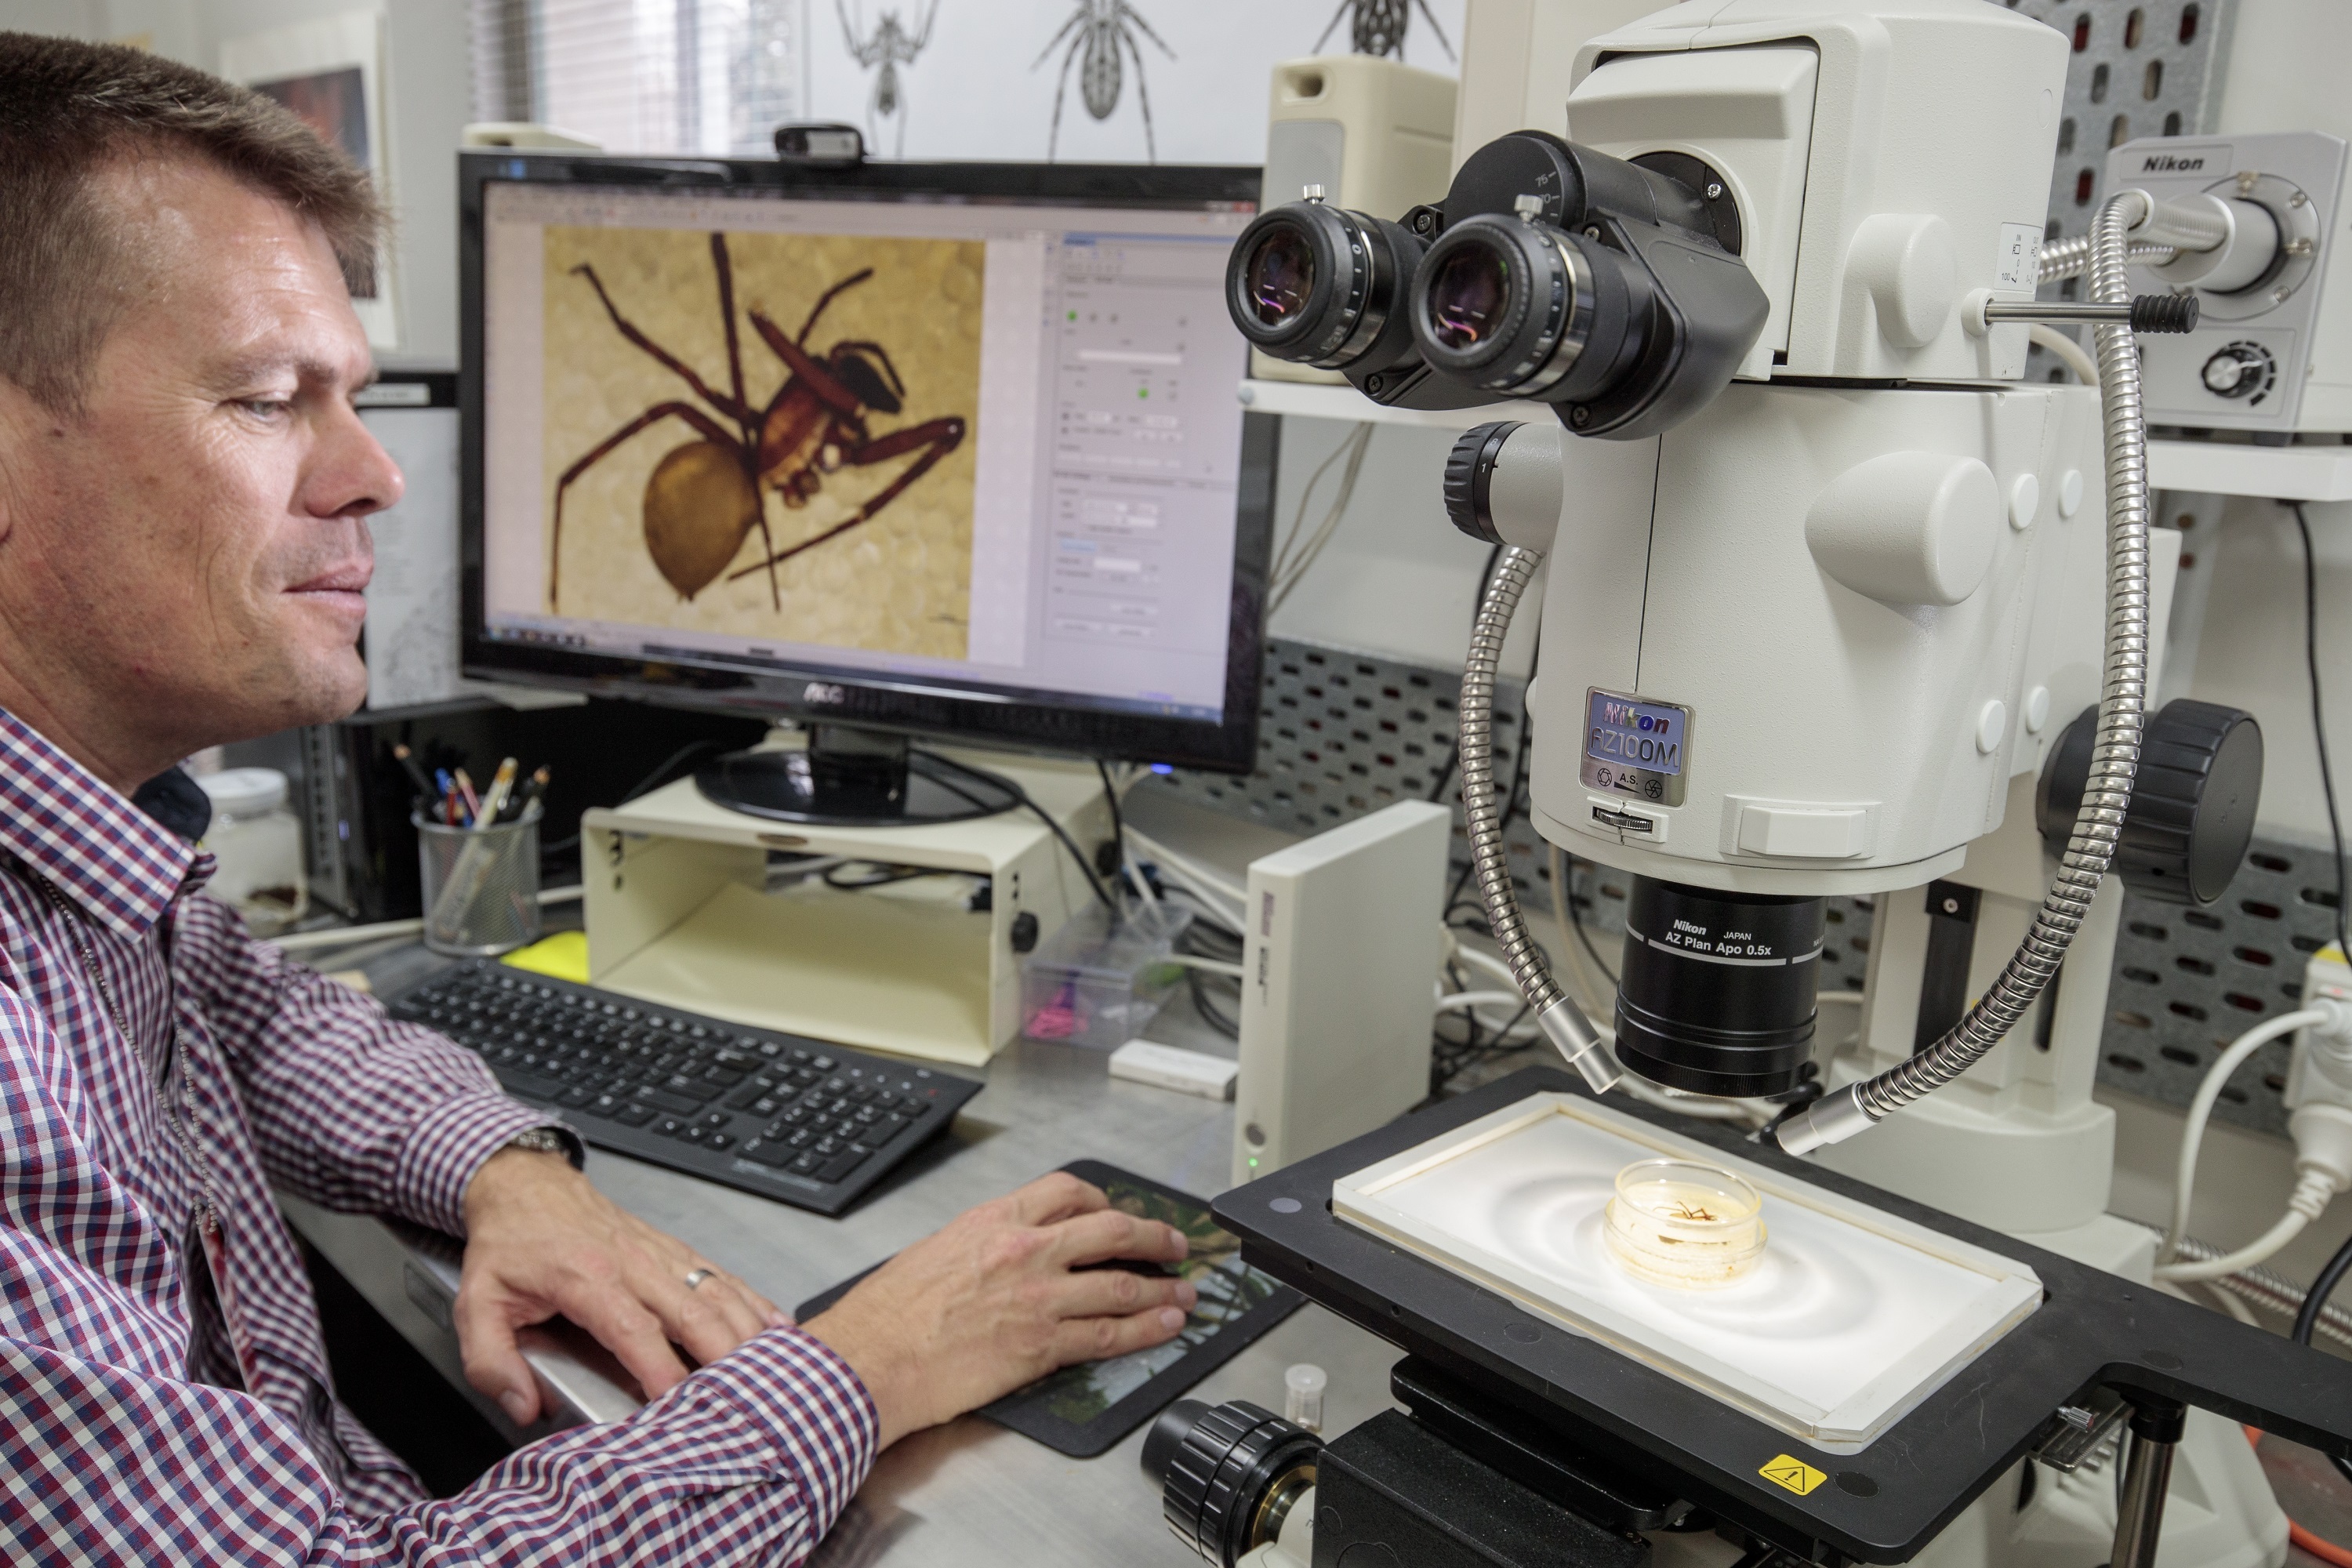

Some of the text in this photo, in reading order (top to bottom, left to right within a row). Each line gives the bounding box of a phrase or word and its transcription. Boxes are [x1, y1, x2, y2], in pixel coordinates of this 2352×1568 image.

[2142, 155, 2205, 171] Nikon
[1535, 173, 1548, 187] 75
[2002, 272, 2011, 281] 100
[1490, 437, 1498, 446] 8
[1482, 463, 1486, 473] 1
[1603, 702, 1671, 735] Nikon
[1591, 726, 1679, 768] AZ100M
[1620, 773, 1639, 786] A.S.
[1673, 919, 1708, 936] Nikon
[1723, 931, 1751, 941] JAPAN
[1665, 931, 1772, 956] AZ Plan Apo 0.5x
